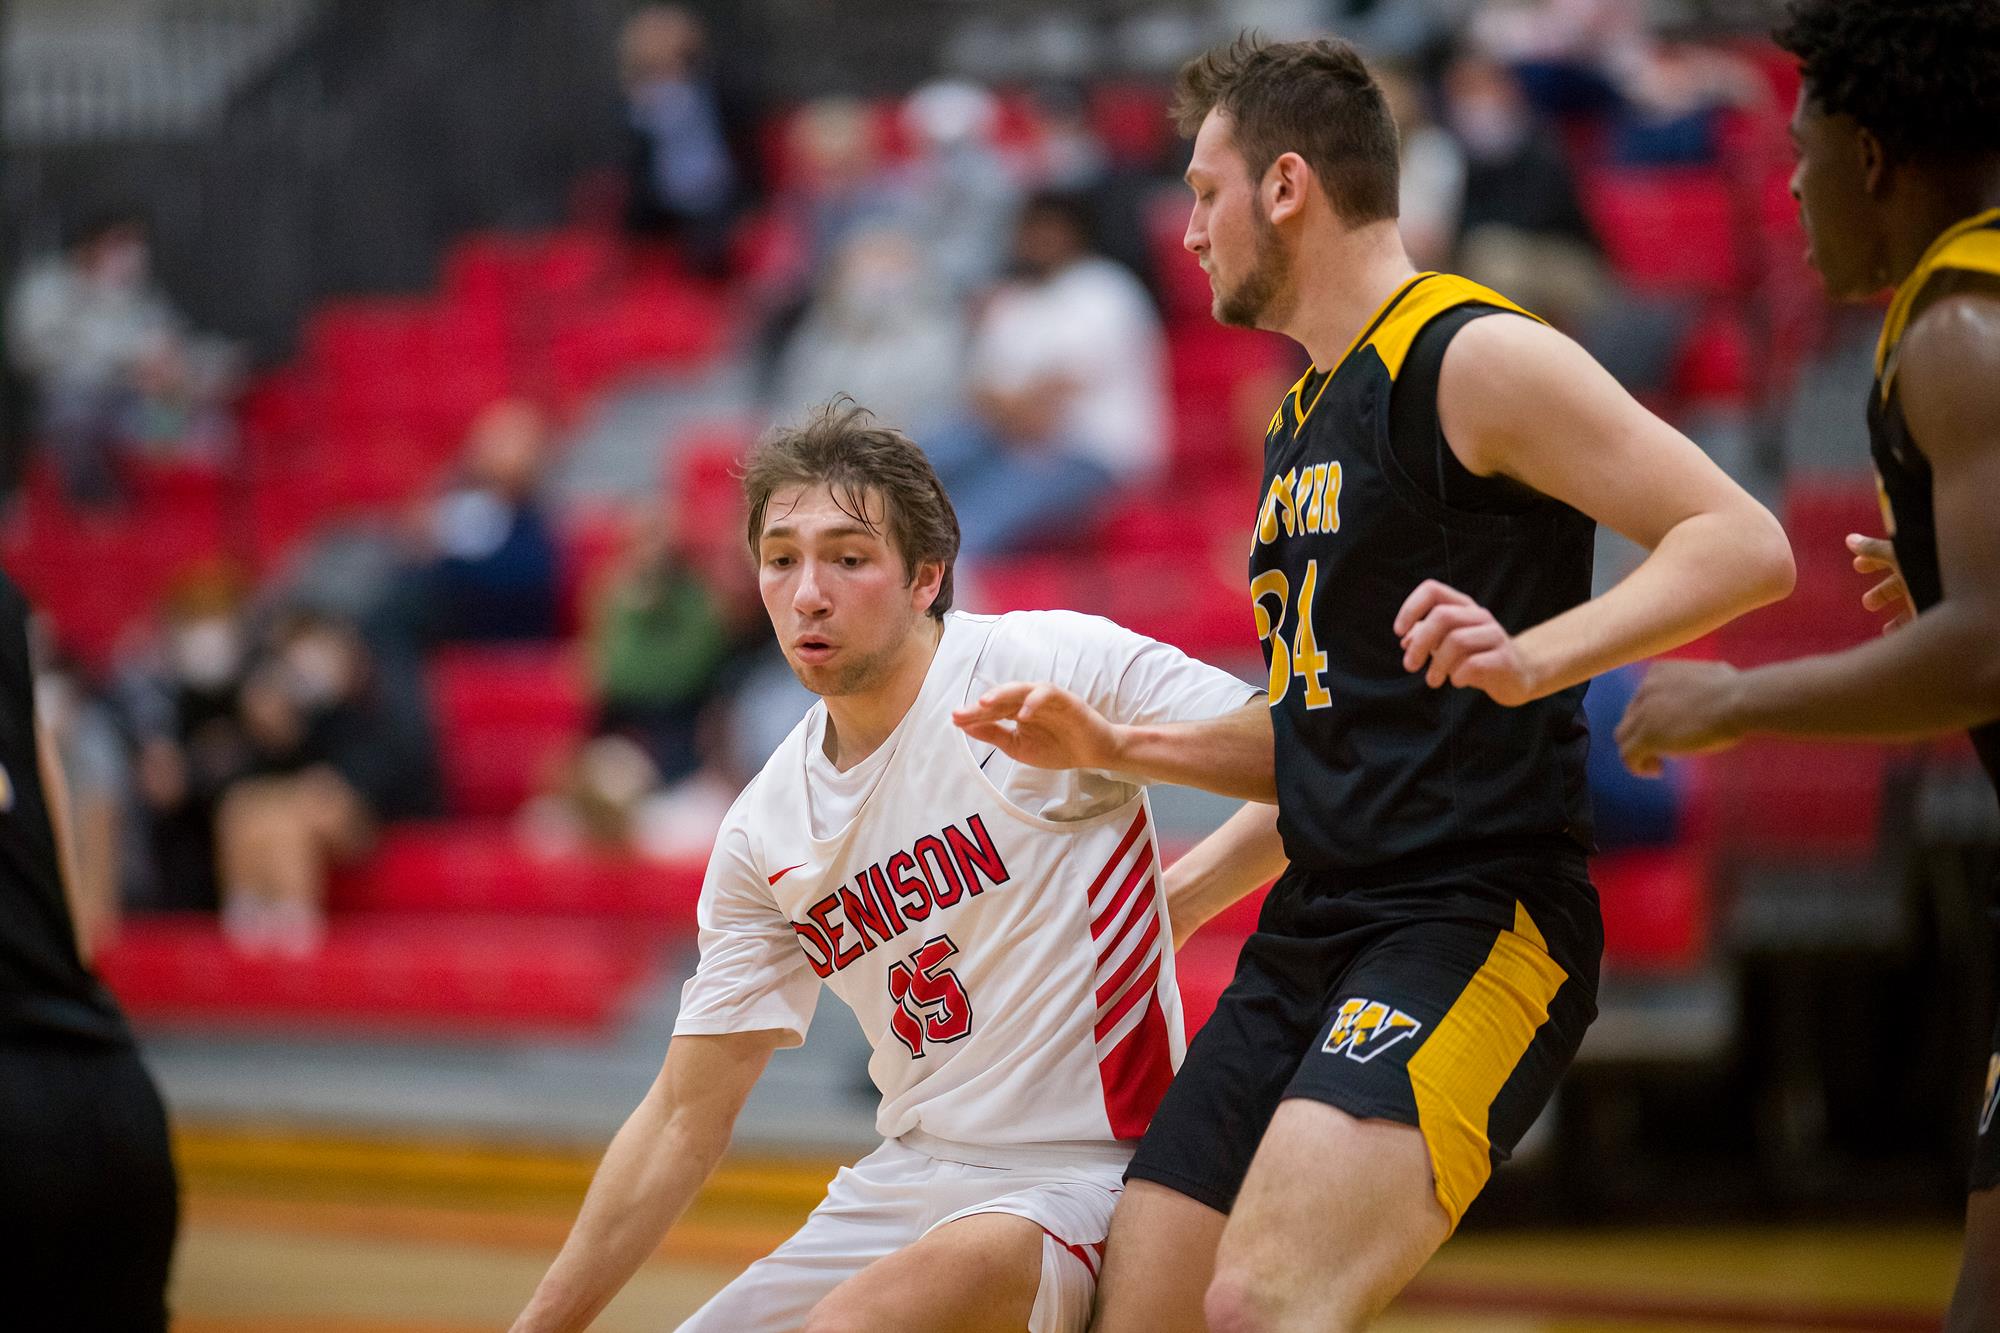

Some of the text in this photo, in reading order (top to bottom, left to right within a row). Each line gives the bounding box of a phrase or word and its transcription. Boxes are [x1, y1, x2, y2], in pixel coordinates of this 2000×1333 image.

[1250, 559, 1332, 710] 34
[790, 813, 1011, 979] DENISON
[888, 933, 973, 1060] 15
[1321, 998, 1422, 1063] W
